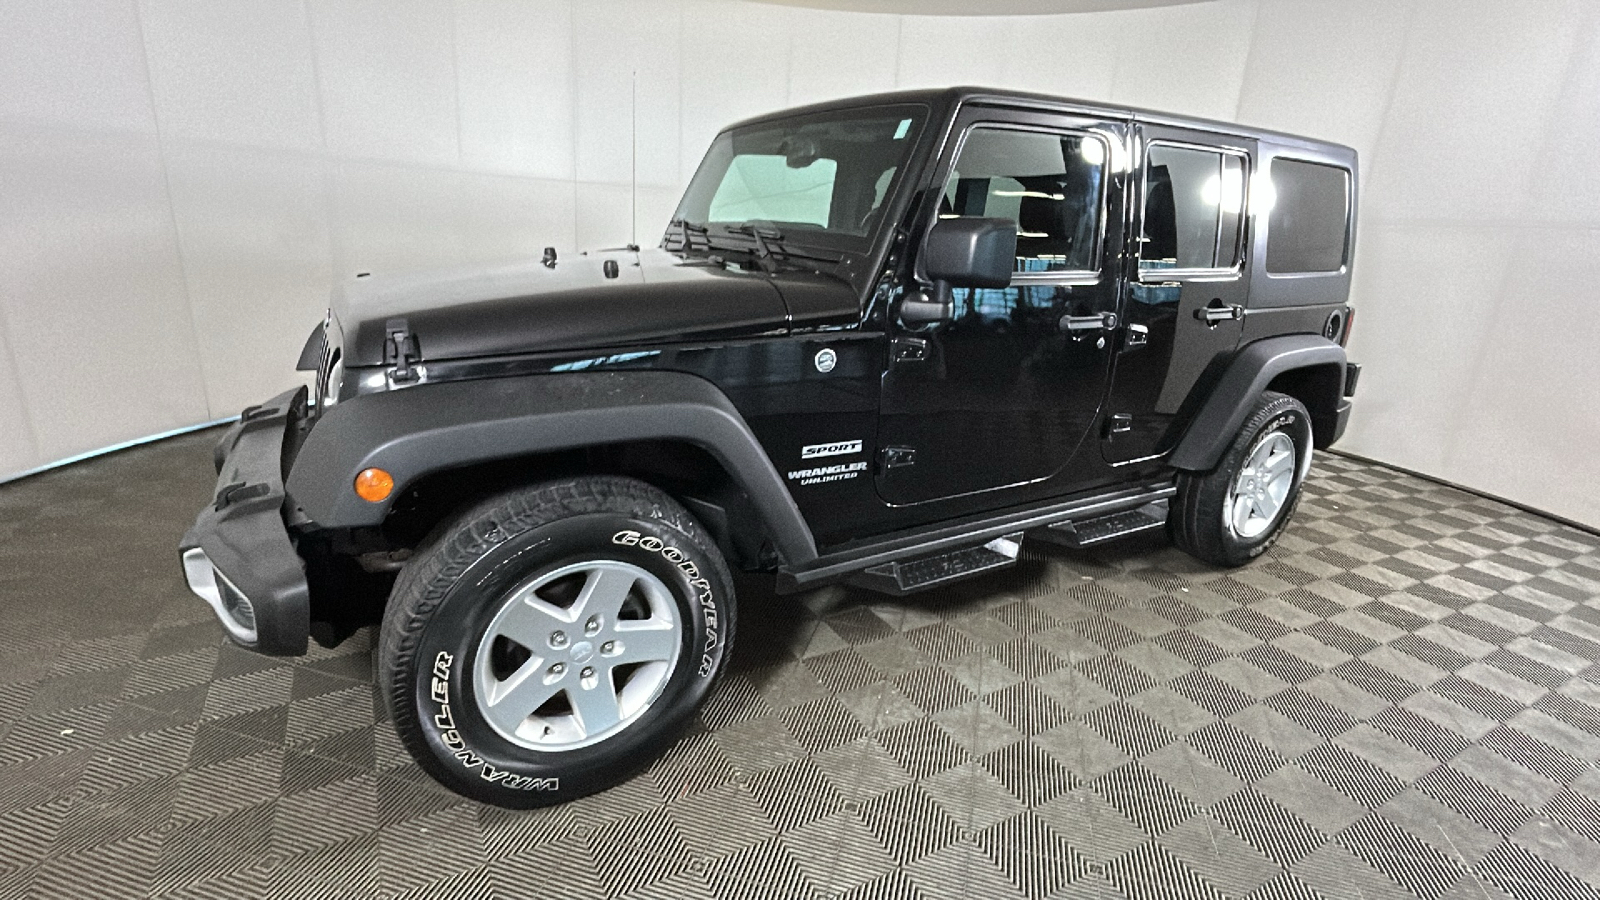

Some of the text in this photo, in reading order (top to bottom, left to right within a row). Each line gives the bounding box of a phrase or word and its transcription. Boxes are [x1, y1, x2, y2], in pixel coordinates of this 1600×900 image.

[805, 443, 860, 454] SPORT
[788, 462, 867, 479] WRANGLER
[801, 472, 858, 485] UNLIMITED
[612, 530, 720, 678] GOODYEAR
[431, 651, 559, 791] WRANGLER
